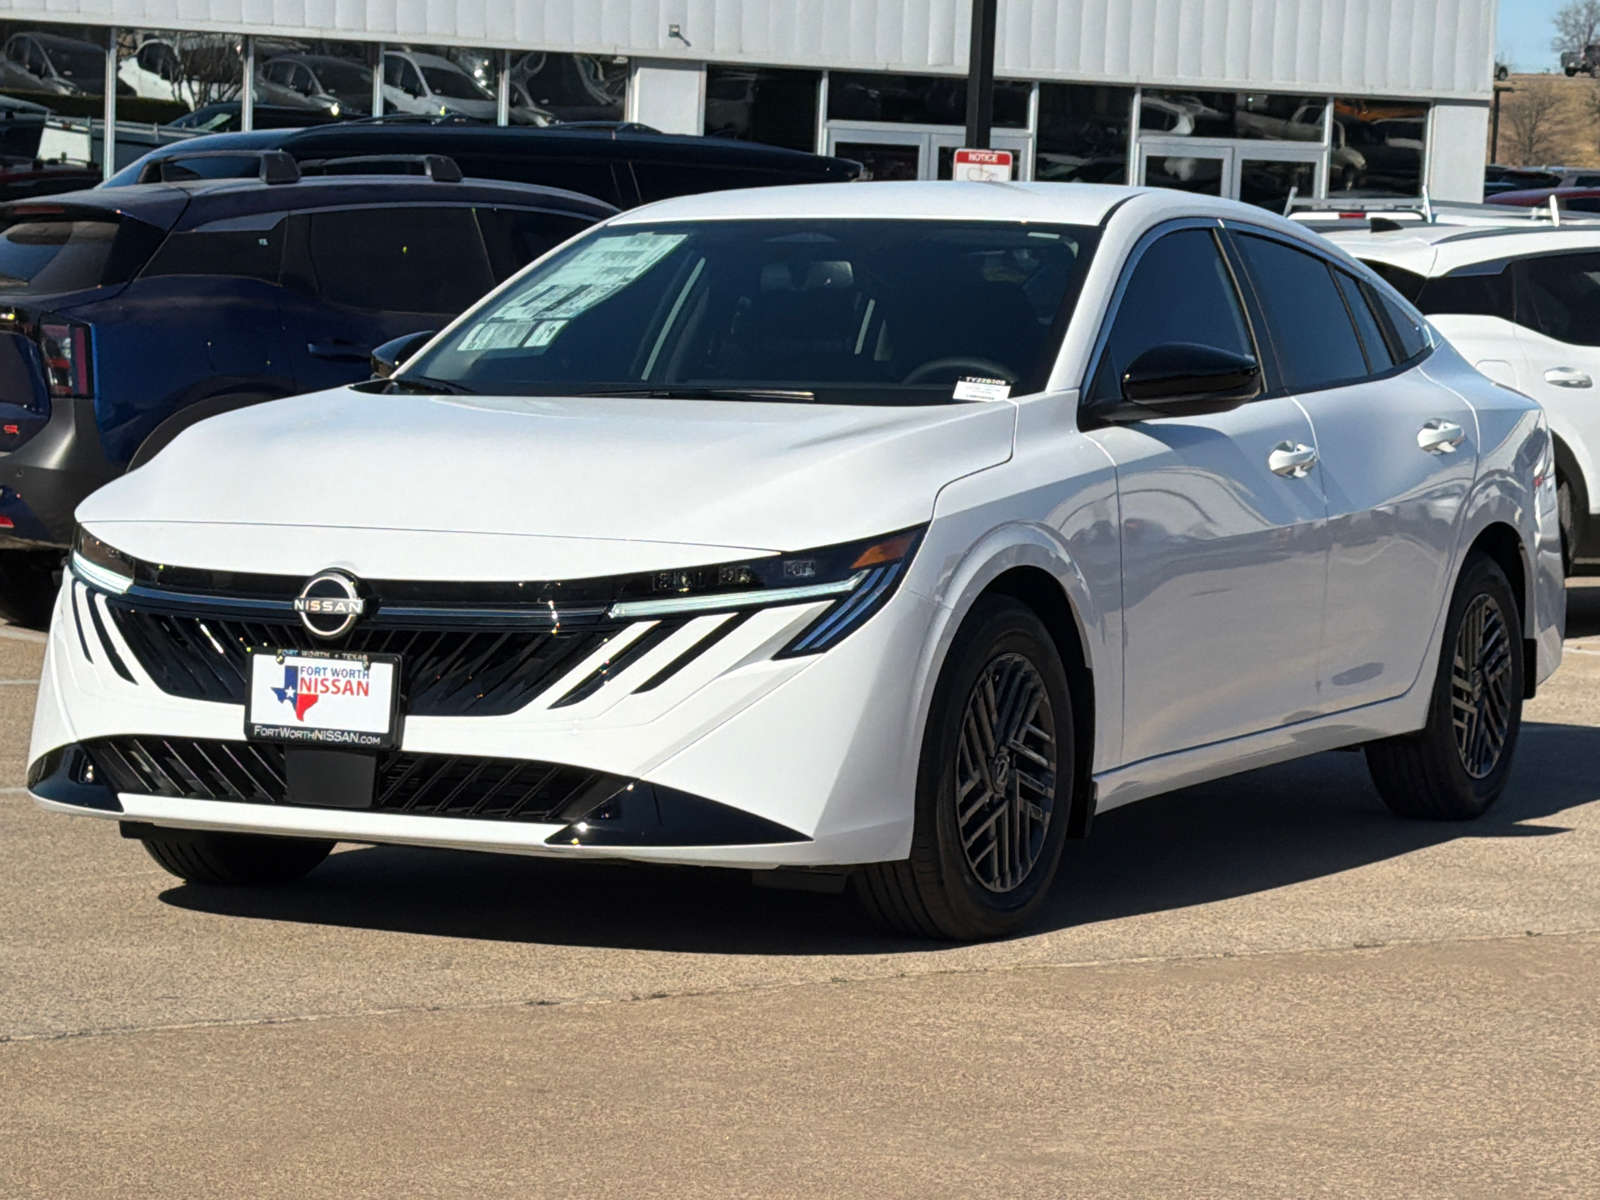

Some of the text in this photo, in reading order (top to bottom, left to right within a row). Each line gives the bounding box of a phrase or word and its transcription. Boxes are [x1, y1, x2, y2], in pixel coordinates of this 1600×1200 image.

[968, 153, 998, 163] NOTICE
[294, 599, 361, 613] NISSAN
[301, 650, 330, 658] WORTH
[342, 653, 369, 661] TEXAS
[300, 666, 370, 680] FORT WORTH
[300, 677, 370, 697] NISSAN
